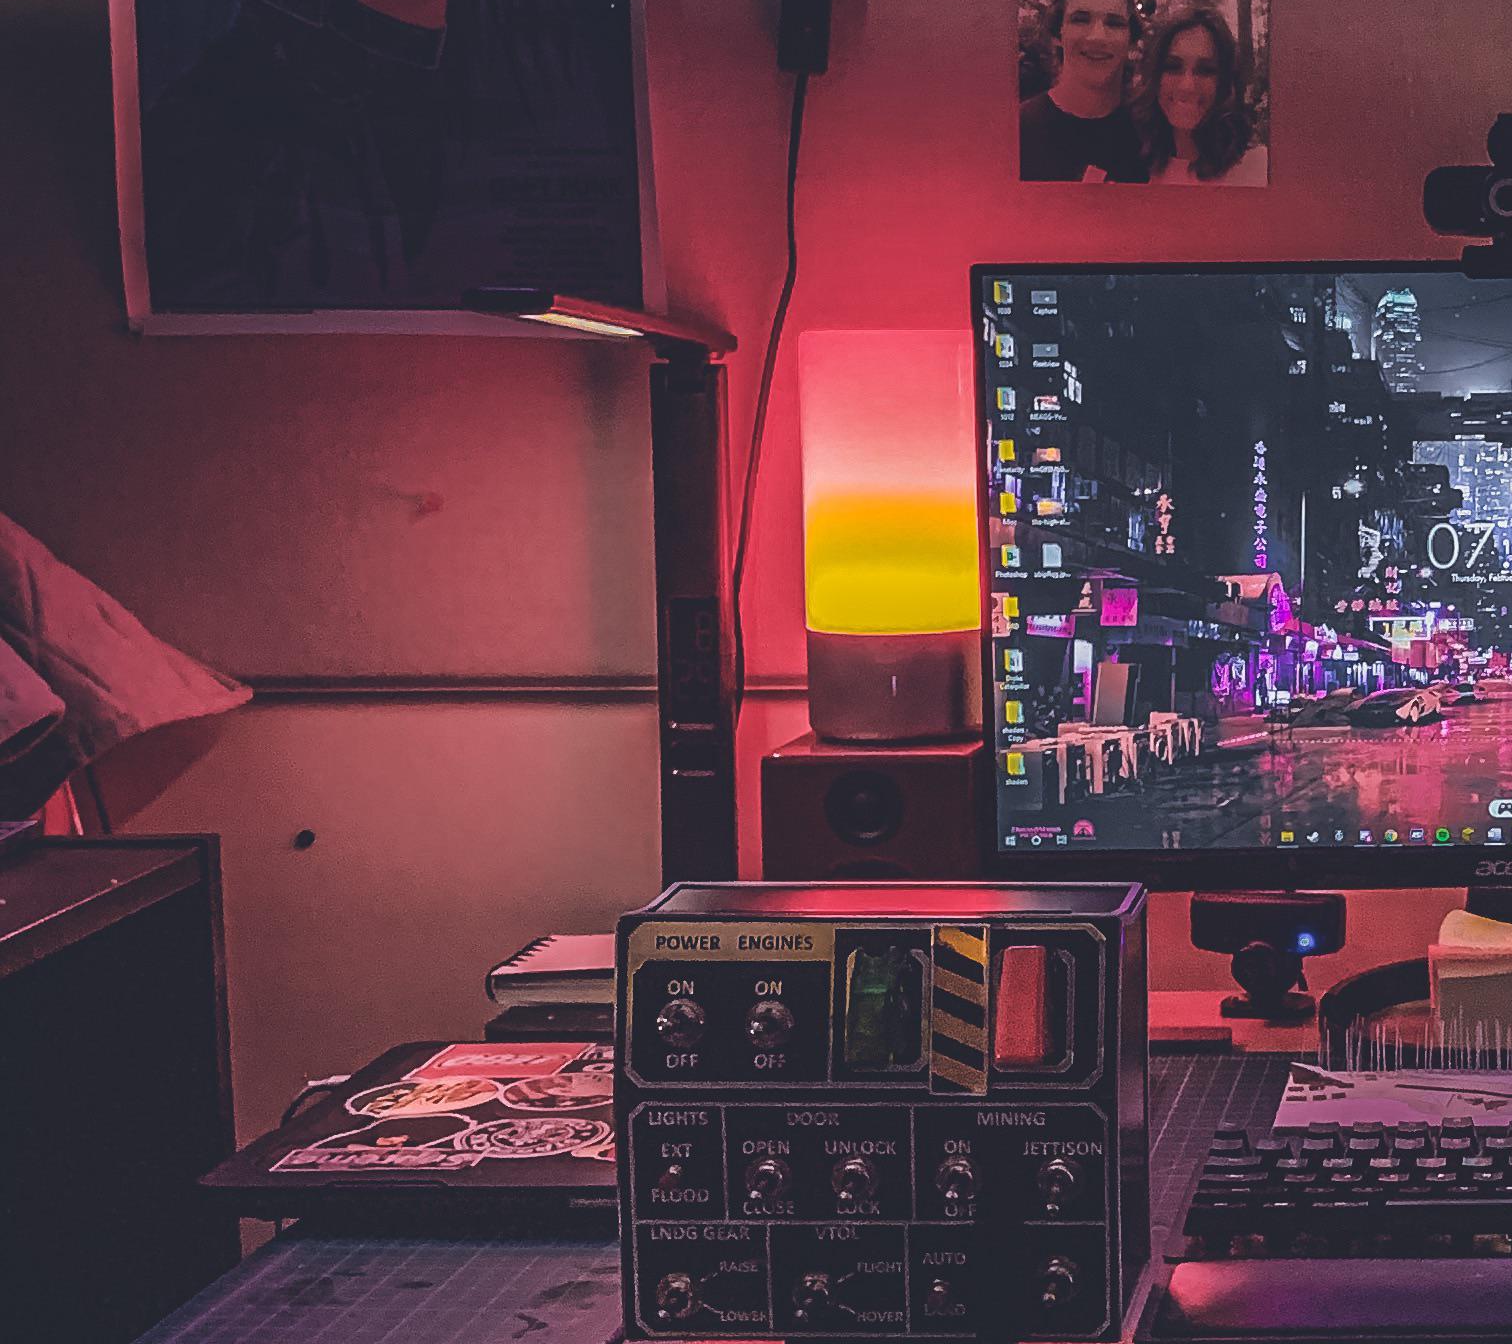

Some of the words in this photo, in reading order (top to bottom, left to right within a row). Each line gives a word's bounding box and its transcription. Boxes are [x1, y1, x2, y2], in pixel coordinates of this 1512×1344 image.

[1451, 574, 1487, 583] Thursday,
[655, 935, 721, 951] POWER
[737, 935, 814, 951] ENGINES
[667, 979, 695, 995] ON
[754, 980, 782, 996] ON
[666, 1054, 699, 1069] OFF
[753, 1054, 787, 1069] OFF
[648, 1111, 709, 1126] LIGHTS
[786, 1112, 840, 1127] DOOR
[977, 1111, 1047, 1127] MINING
[661, 1142, 694, 1158] EXT
[742, 1140, 791, 1155] OPEN
[824, 1140, 897, 1155] UNLOCK
[943, 1139, 972, 1154] ON
[1023, 1141, 1103, 1156] JETTISON
[651, 1188, 710, 1204] FLOOD
[742, 1202, 795, 1216] CLOSE
[836, 1201, 881, 1216] LOCK
[650, 1226, 699, 1241] LNDG
[703, 1226, 751, 1241] GEAR
[815, 1226, 860, 1241] VTOL
[922, 1252, 967, 1265] AUTO
[719, 1260, 760, 1274] RAISE
[856, 1261, 903, 1274] FLIGHT
[719, 1311, 768, 1323] LOWER
[857, 1311, 905, 1323] HOVER
